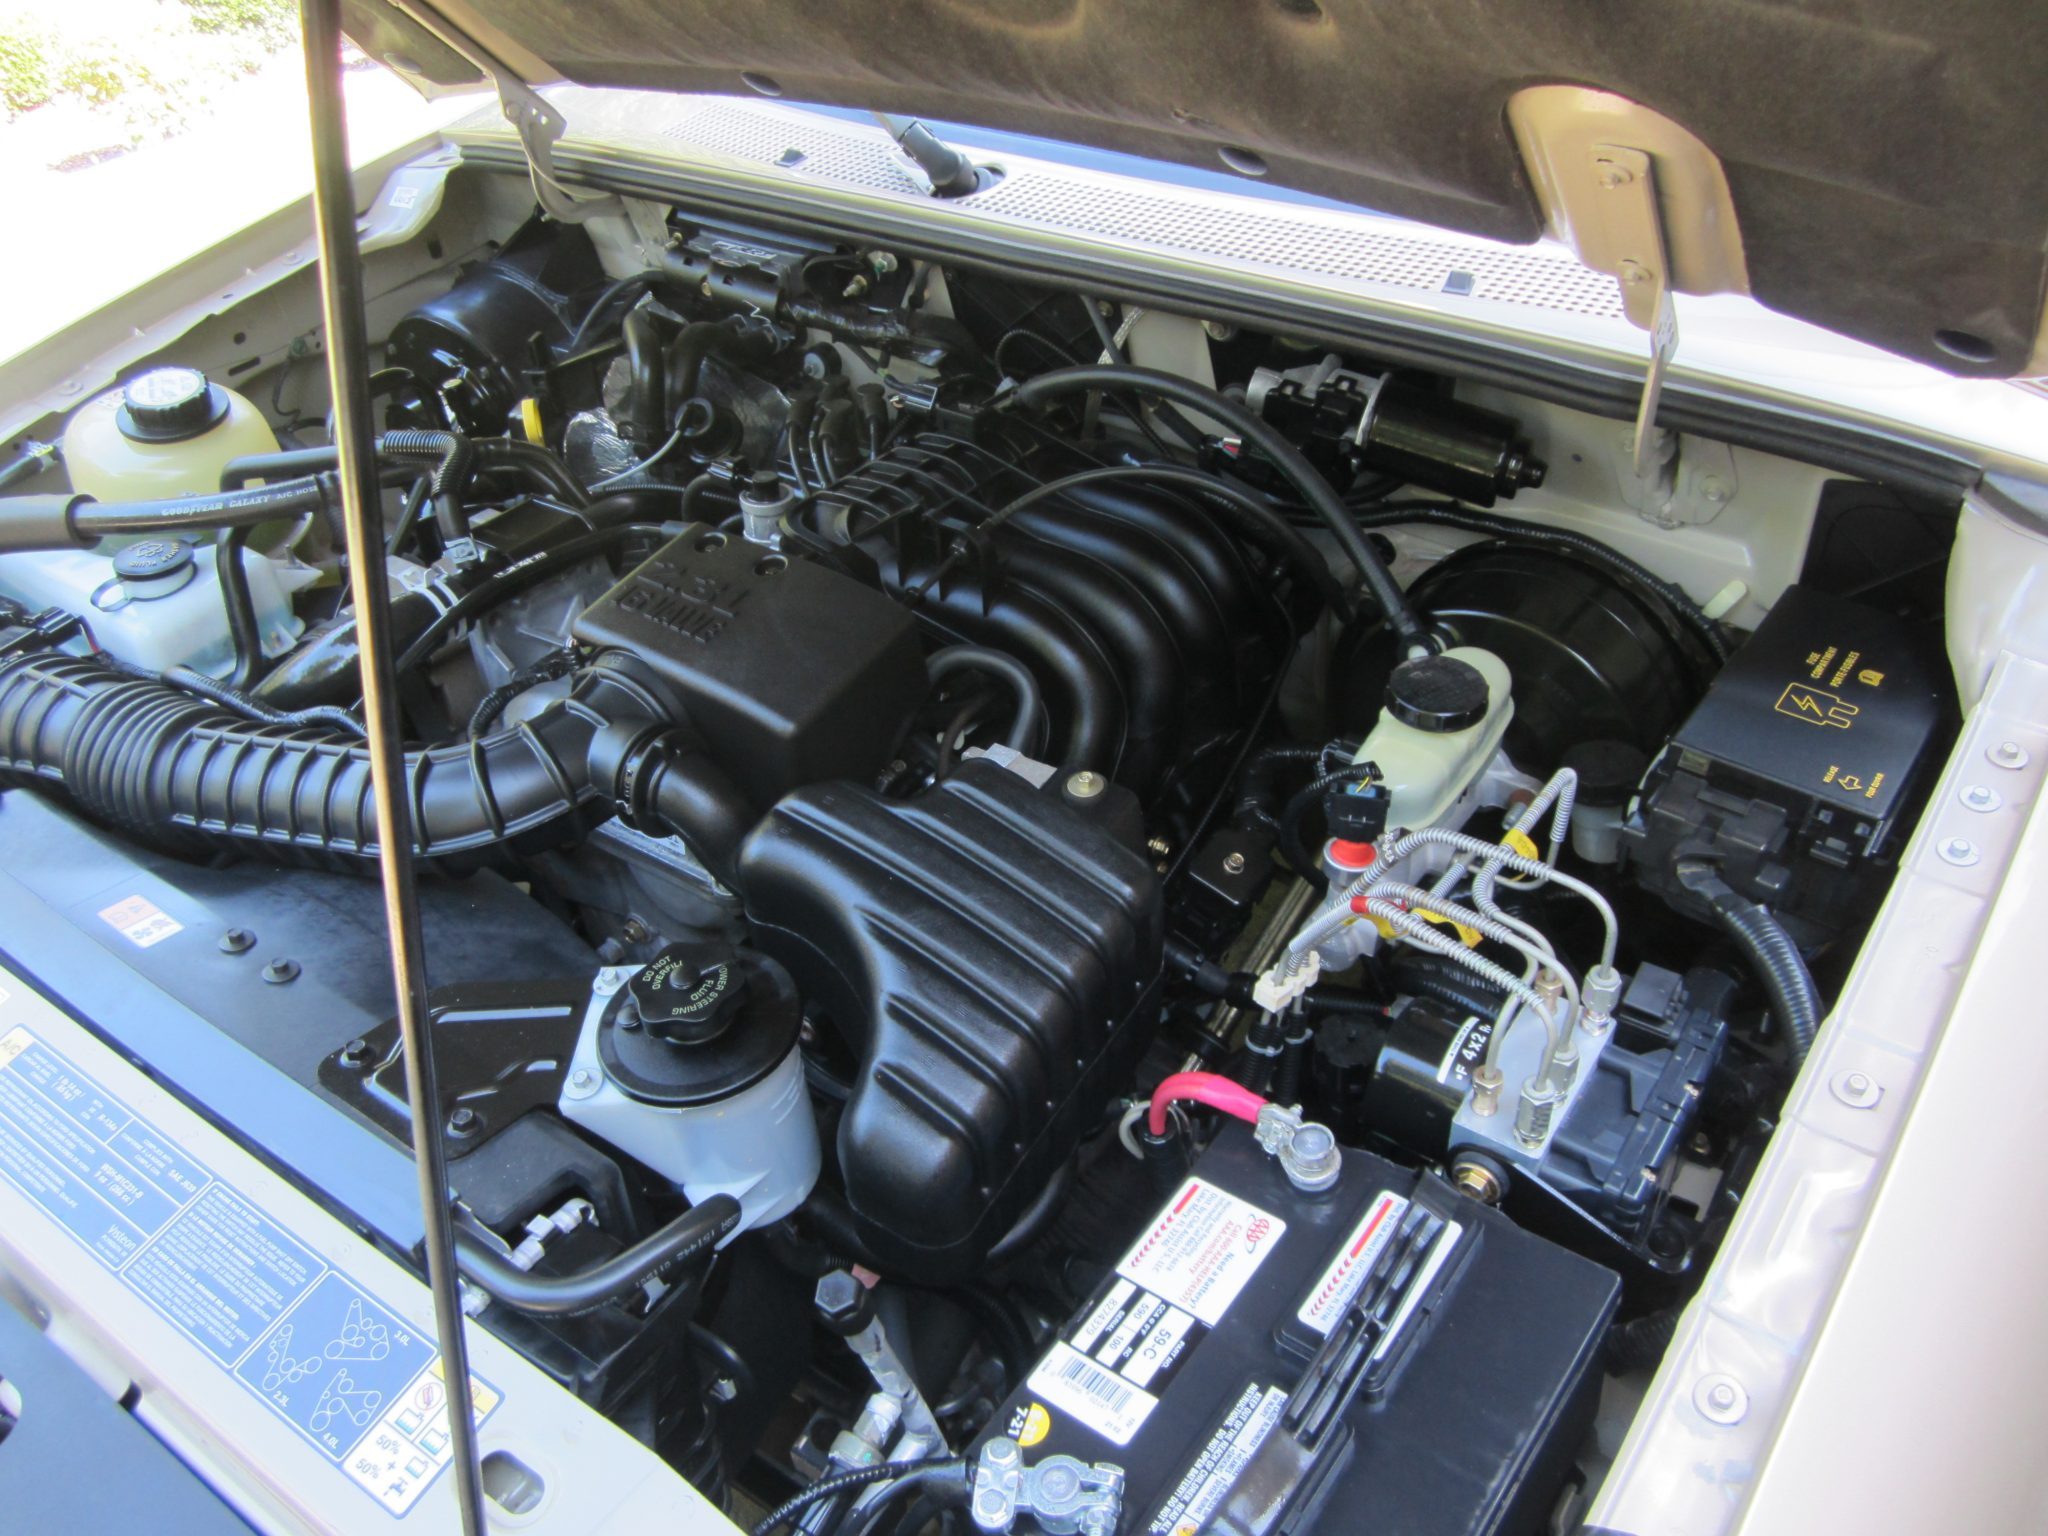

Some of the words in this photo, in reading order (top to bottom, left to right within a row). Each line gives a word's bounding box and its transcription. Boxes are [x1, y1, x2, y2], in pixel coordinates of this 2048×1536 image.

[161, 502, 224, 516] GOODYEAR
[229, 495, 271, 508] GALAXY
[642, 970, 655, 982] DO
[652, 955, 671, 970] NOT
[715, 964, 728, 991] OWER
[690, 979, 714, 1001] FLUID
[671, 991, 718, 1015] STEERING
[1462, 1032, 1486, 1060] 4x2
[106, 1224, 138, 1250] Visteon
[1246, 1217, 1270, 1245] AAA
[1216, 1251, 1233, 1271] Need
[1188, 1275, 1213, 1310] Battery?
[1085, 1297, 1118, 1336] 8274379
[1132, 1302, 1149, 1320] 590
[1153, 1303, 1165, 1318] CCA
[1104, 1308, 1125, 1334] SERIAL
[394, 1330, 411, 1346] 3.0L
[1108, 1333, 1124, 1351] 100
[1142, 1328, 1171, 1360] 59-C
[1121, 1345, 1133, 1358] RC
[1170, 1339, 1184, 1357] PART
[273, 1391, 291, 1407] 2.3L
[1248, 1391, 1261, 1408] KEEP
[1007, 1405, 1030, 1436] 7-21
[1239, 1407, 1251, 1420] OUT
[1215, 1427, 1226, 1439] DO
[1232, 1418, 1243, 1430] OF
[1206, 1437, 1218, 1451] NOT
[1224, 1427, 1237, 1442] THE
[375, 1434, 402, 1455] 50%
[1211, 1439, 1228, 1461] REACH
[356, 1458, 381, 1480] 50%
[1194, 1450, 1210, 1469] OPEN
[1203, 1459, 1215, 1471] OF
[1181, 1468, 1208, 1504] CHILDREN.
[1166, 1495, 1178, 1508] DO
[1157, 1506, 1170, 1520] NOT
[1168, 1502, 1184, 1521] READ
[1159, 1519, 1171, 1533] ALL
